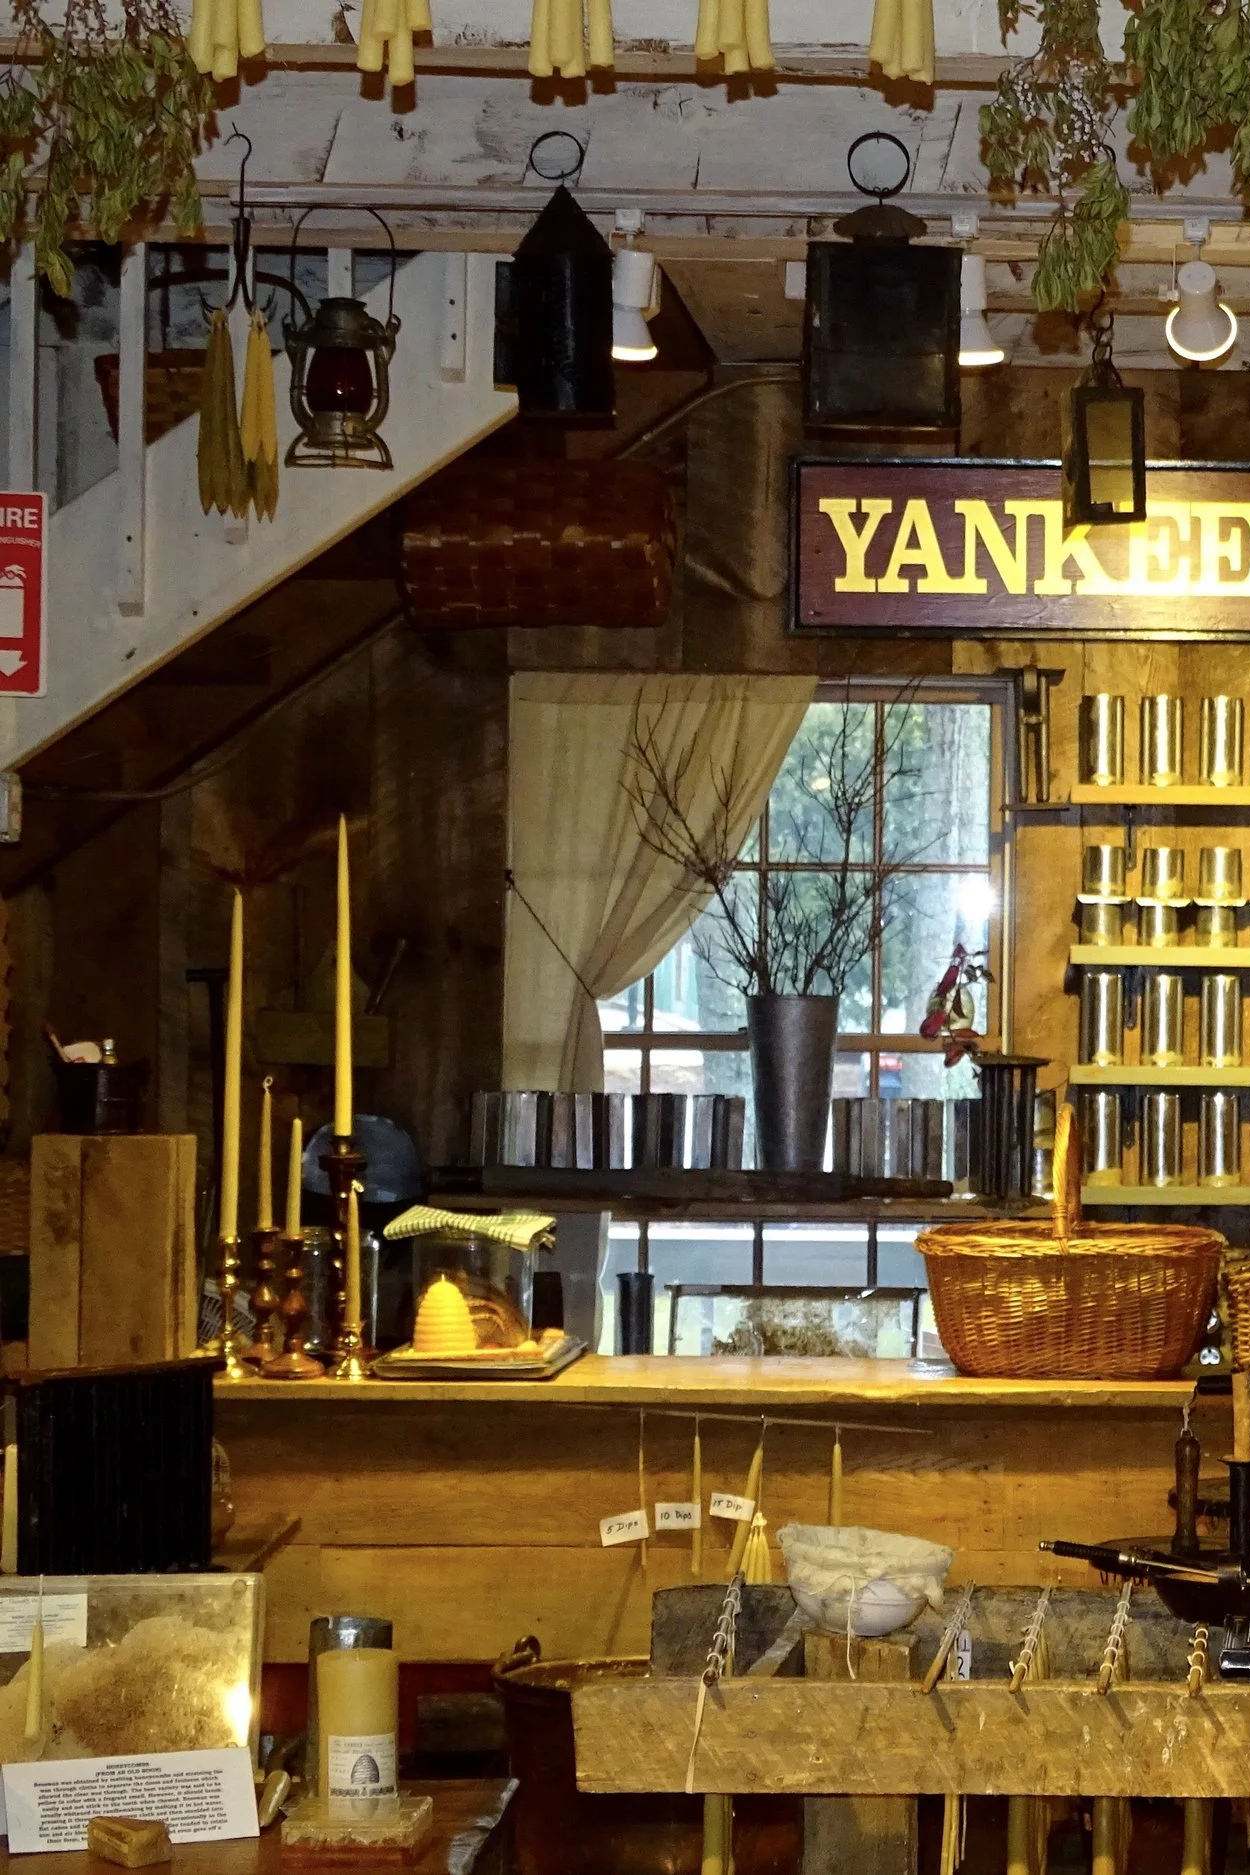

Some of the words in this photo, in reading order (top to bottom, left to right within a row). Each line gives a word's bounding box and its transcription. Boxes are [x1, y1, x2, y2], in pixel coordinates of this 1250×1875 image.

[0, 508, 38, 529] IRE
[660, 1511, 670, 1520] 10
[675, 1511, 692, 1521] Dips
[606, 1525, 613, 1535] 5
[616, 1520, 638, 1532] Dips
